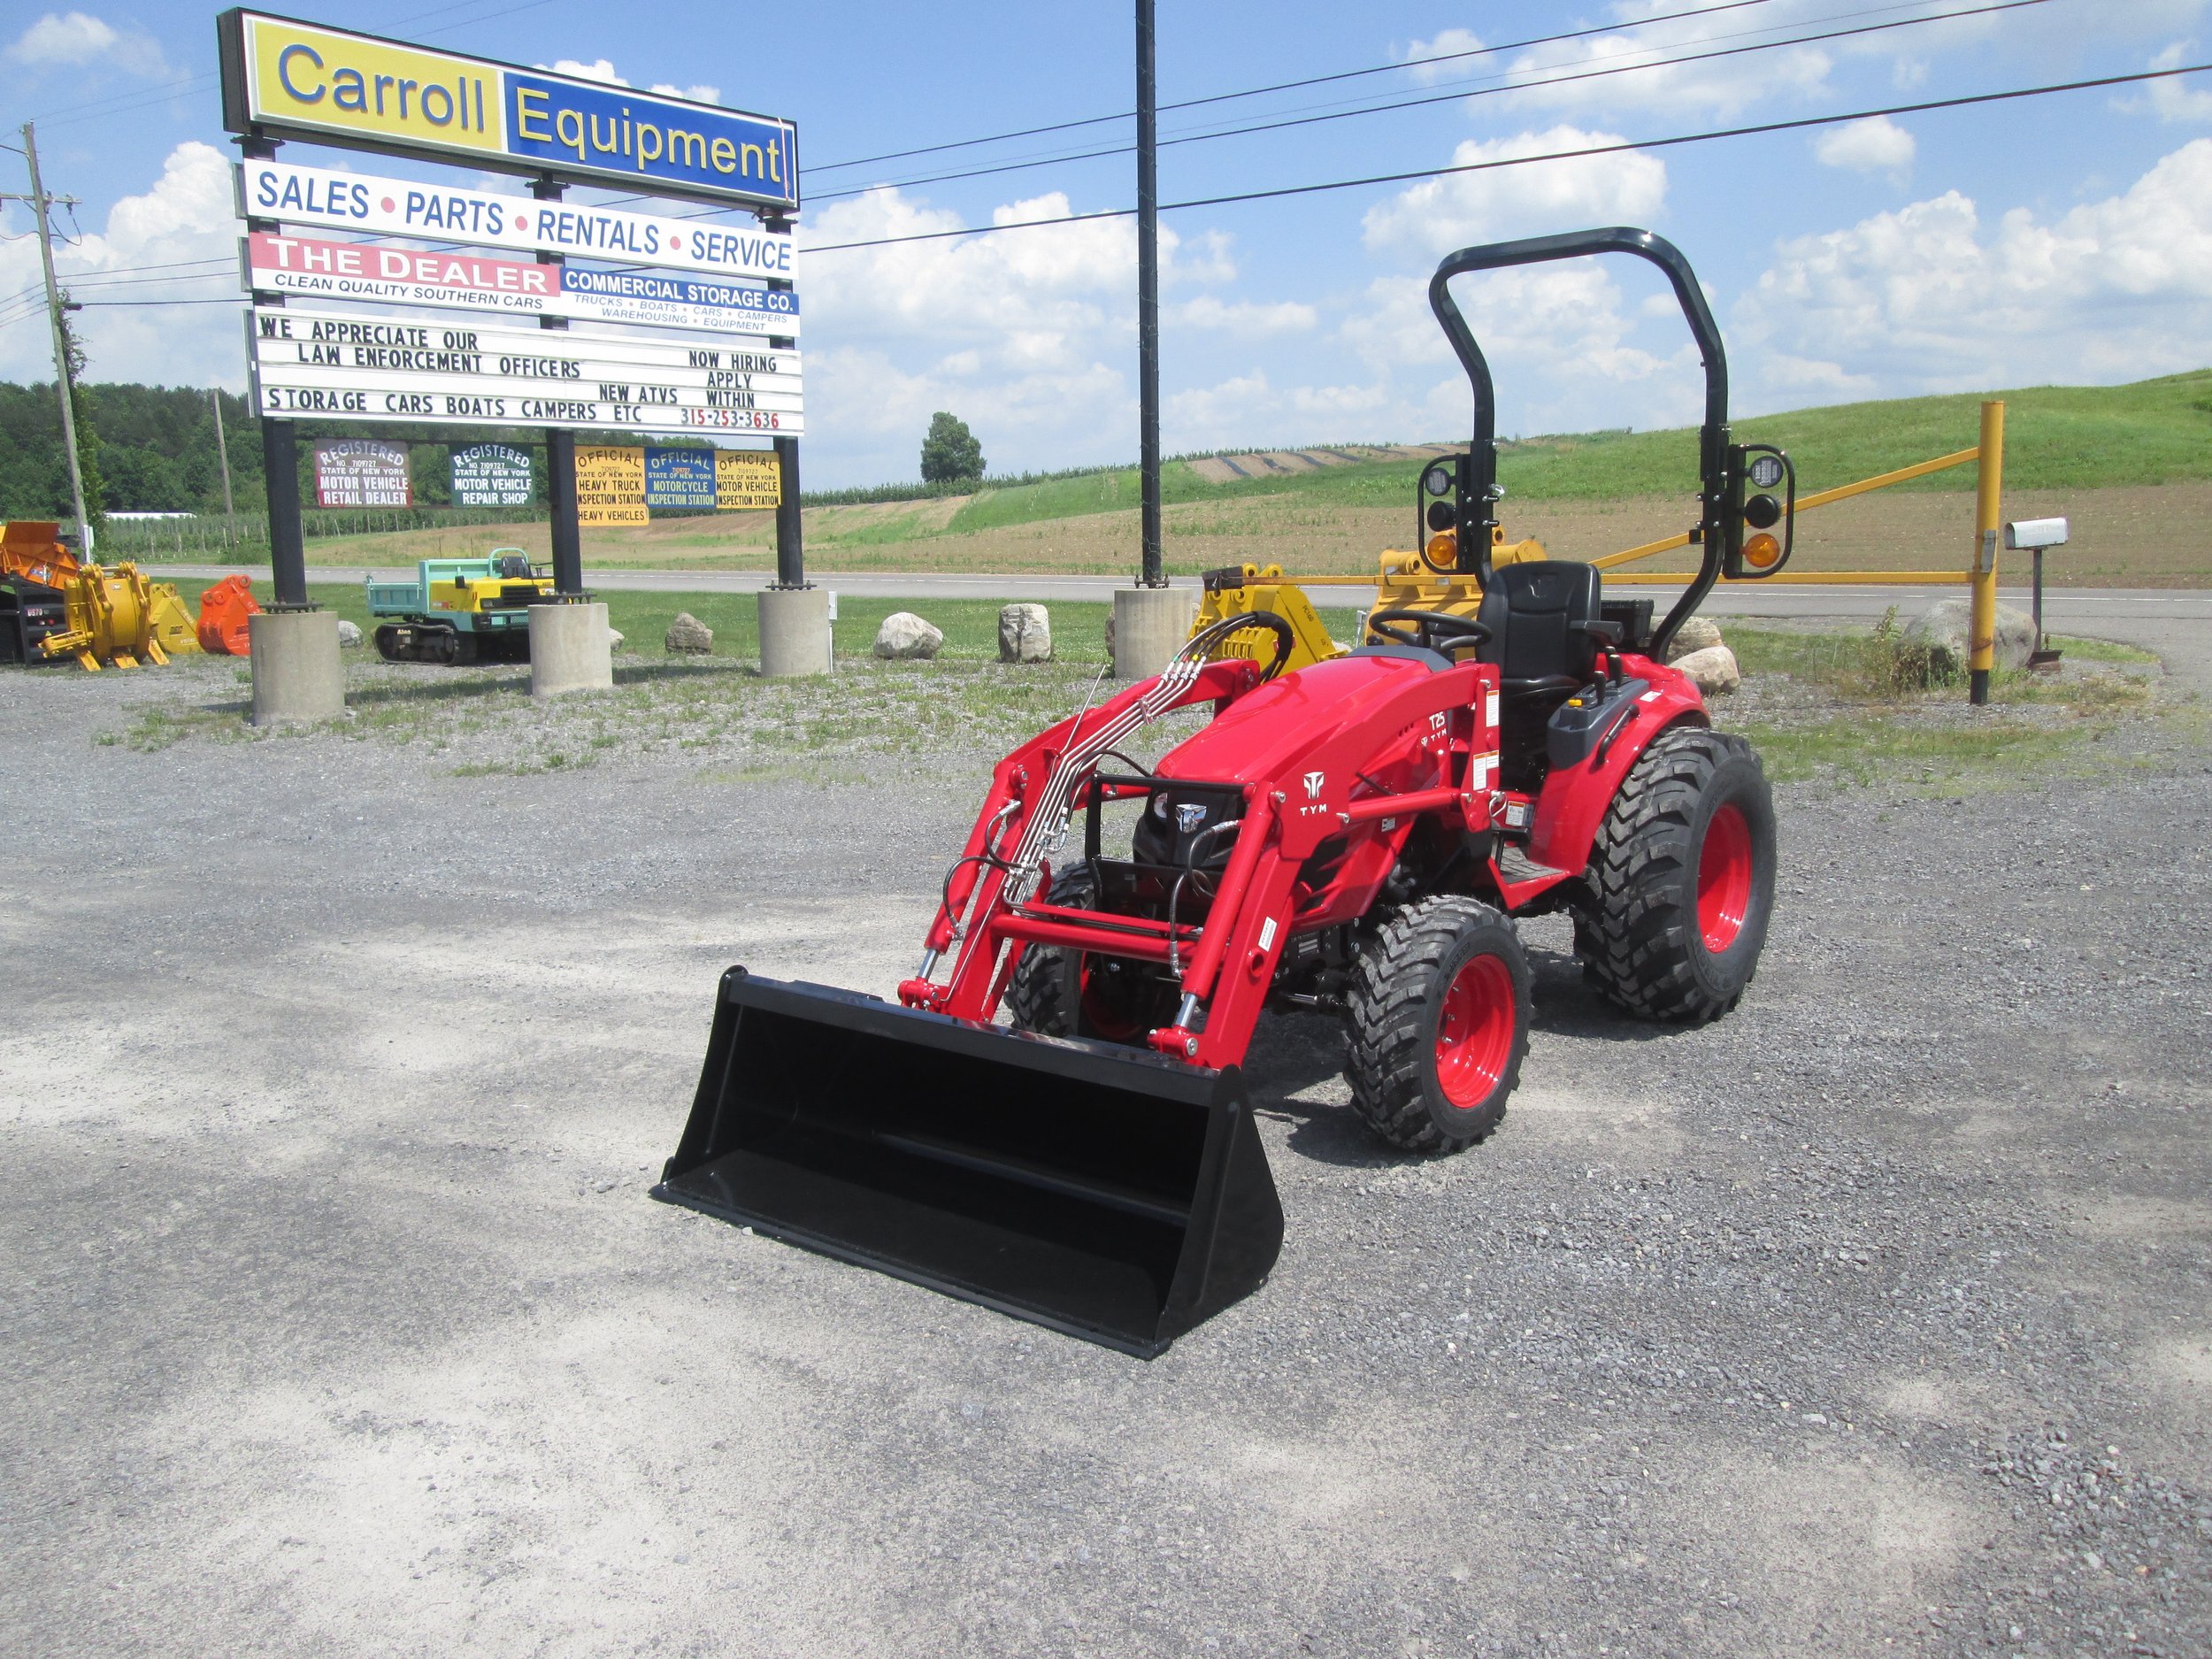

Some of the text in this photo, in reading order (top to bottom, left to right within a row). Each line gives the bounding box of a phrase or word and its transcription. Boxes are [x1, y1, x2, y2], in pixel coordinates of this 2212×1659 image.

[278, 43, 781, 183] Carroll Equipment
[257, 171, 792, 271] SALES PARTS RENTALS SERVICE
[266, 238, 548, 293] THE DEALER
[274, 273, 543, 309] CLEAN QUALITY SOUTHERN CARS
[565, 271, 794, 311] COMMERCIAL STORAGE CO.
[574, 294, 788, 324] TRUCKS BOATS CARS CAMPERS
[602, 308, 766, 331] WAREHOUSING EQUIPMENT
[260, 316, 479, 350] WE APPRECIATE OUR
[297, 343, 580, 379] LAW ENFORCEMENT OFFICERS
[688, 350, 778, 373] NOW HIRING
[707, 372, 752, 389] APPLY
[599, 384, 678, 404] NEW ATVS
[706, 389, 756, 409] WITHIN
[268, 388, 642, 423] STORAGE CARS BOATS CAMPERS ETC
[680, 407, 780, 429] 315-253-3636
[319, 441, 404, 466] REGISTERED
[453, 444, 530, 468] REGISTERED
[578, 449, 641, 468] OFFICIAL
[650, 451, 710, 471] OFFICIAL
[719, 454, 774, 472] OFFICIAL
[319, 476, 409, 490] MOTOR VEHICLE
[454, 478, 489, 490] MOTOR
[579, 480, 641, 491] HEAVY TRUCK
[653, 480, 708, 493] MOTORCYCLE
[716, 481, 778, 492] MOTOR VEHICLE
[323, 491, 408, 505] RETAIL DEALER
[462, 492, 528, 505] REPAIR SHOP
[577, 493, 646, 504] NSPECTION STATION
[648, 493, 715, 505] INSPECTION STATION
[716, 495, 779, 505] INSPECTION STATION
[578, 511, 645, 520] HEAVY VEHICLES
[1429, 710, 1447, 731] T25
[1430, 727, 1448, 742] TYM
[1300, 803, 1327, 817] TYM
